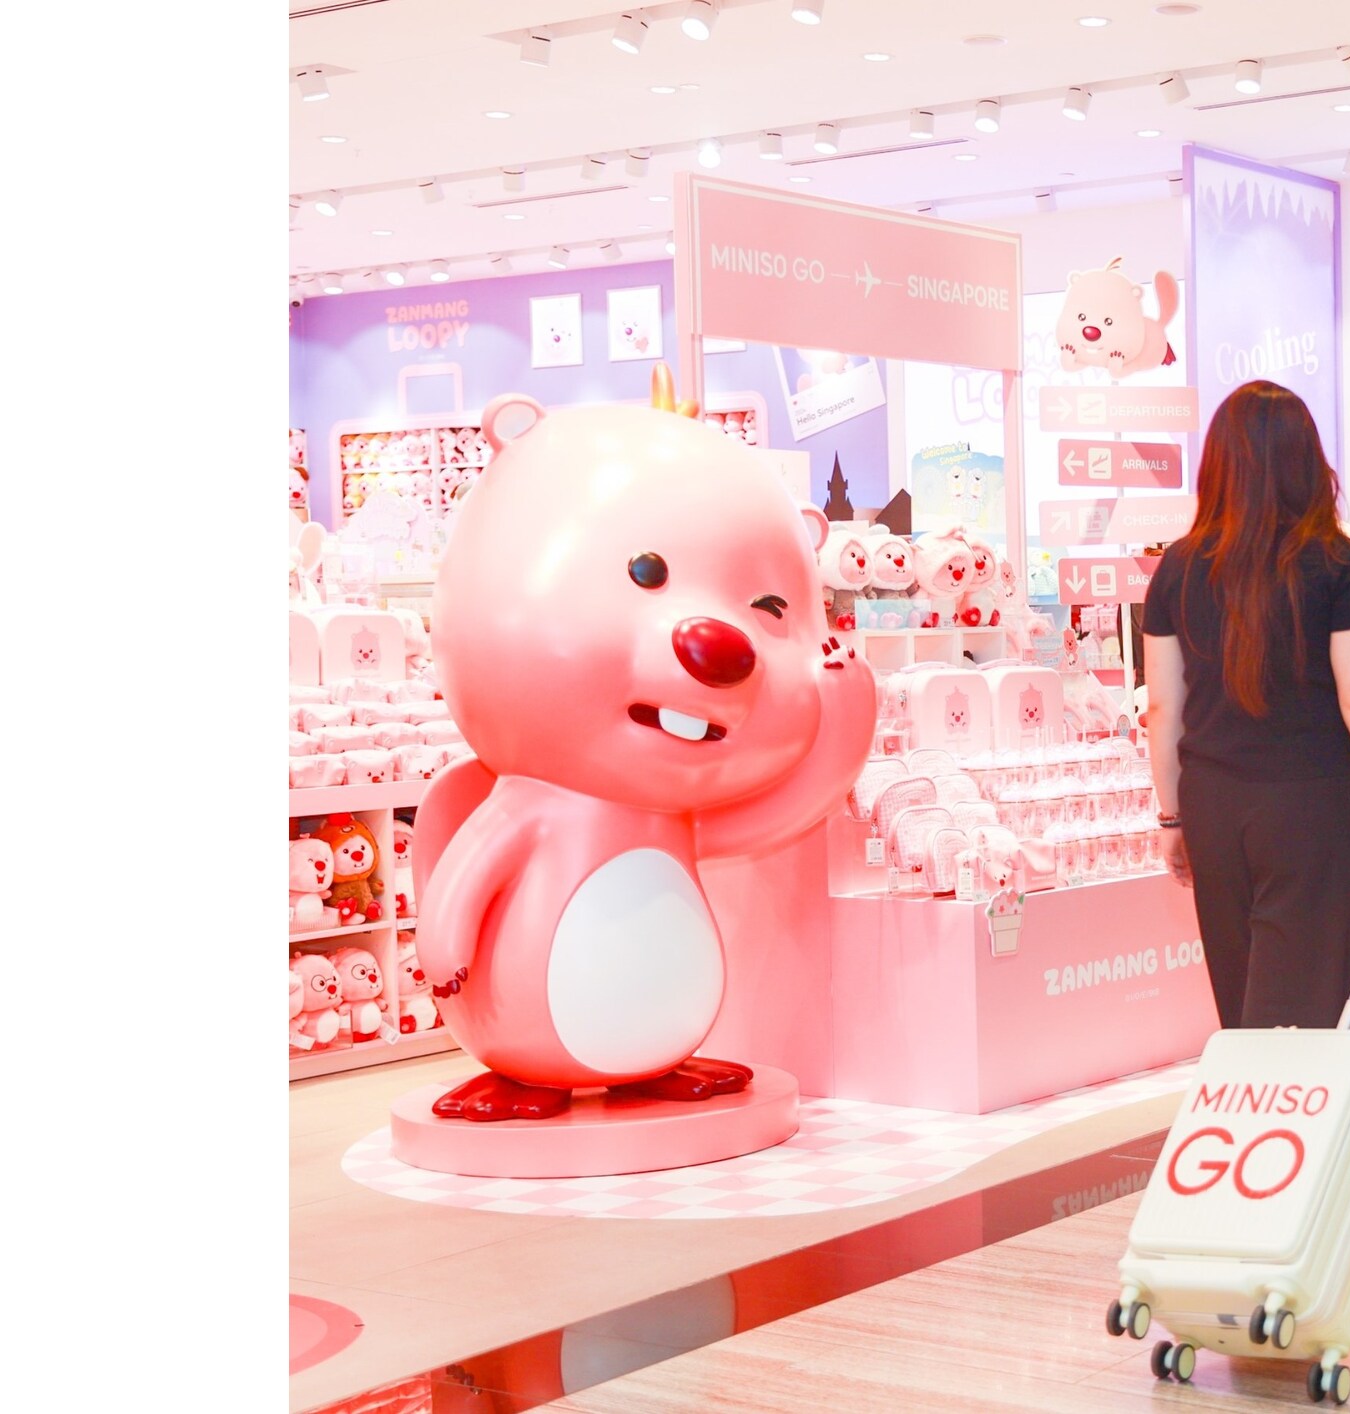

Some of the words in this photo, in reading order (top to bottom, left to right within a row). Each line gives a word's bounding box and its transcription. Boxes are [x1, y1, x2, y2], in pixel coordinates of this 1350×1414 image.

[710, 243, 787, 279] MINISO
[792, 257, 825, 284] GO
[907, 274, 1010, 312] SINGAPORE
[385, 299, 469, 323] ZANMANG
[387, 320, 470, 352] LOOPY
[1215, 326, 1319, 385] Cooling
[796, 412, 817, 426] Hello
[817, 397, 855, 417] Singapore
[1109, 405, 1191, 417] DEPARTURES
[1122, 459, 1168, 471] ARRIVALS
[1123, 513, 1188, 526] CHECK-IN
[1043, 947, 1159, 995] ZANMANG
[1165, 939, 1205, 971] LOO
[1190, 1082, 1329, 1117] MINISO
[1166, 1125, 1305, 1200] GO
